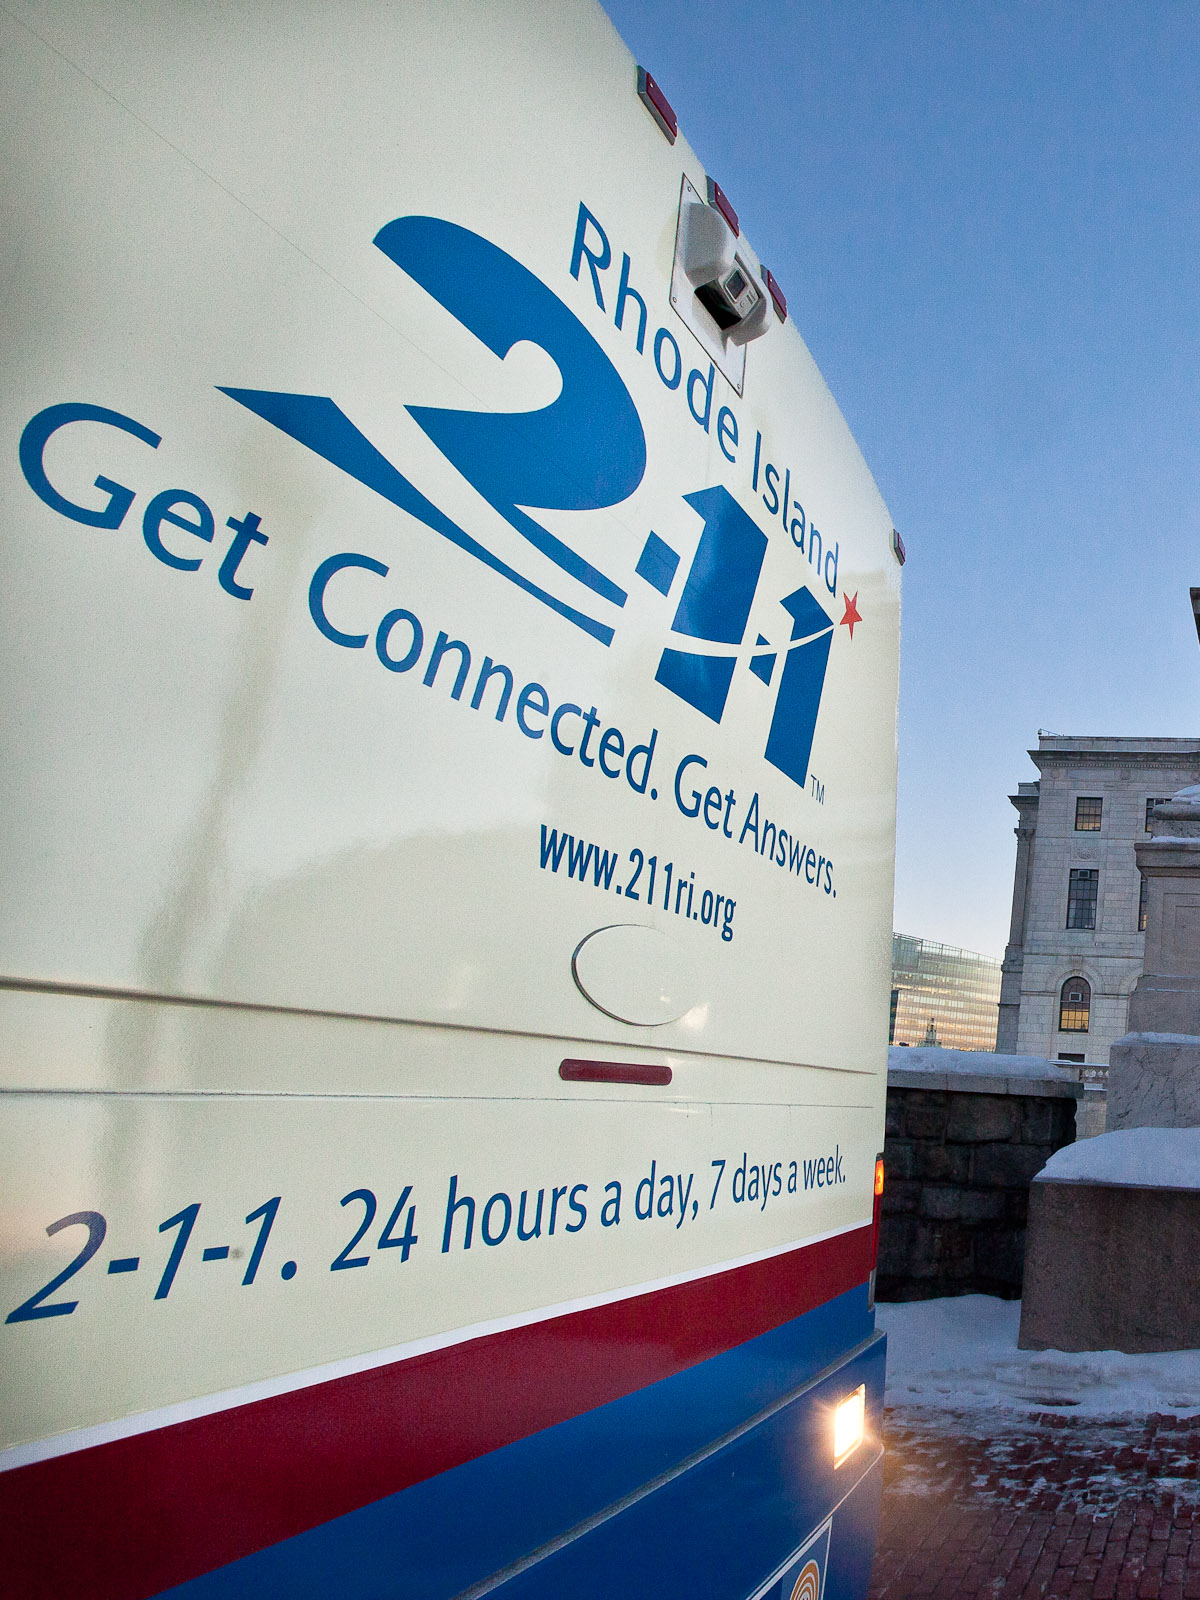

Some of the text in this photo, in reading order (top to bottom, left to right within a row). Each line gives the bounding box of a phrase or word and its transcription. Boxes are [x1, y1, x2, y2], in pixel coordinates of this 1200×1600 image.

[569, 200, 840, 599] Rhode Island
[18, 401, 837, 899] Get Connected. Get Answers.
[810, 773, 826, 806] TM
[539, 823, 737, 943] www.211ri.org
[4, 1143, 847, 1326] 2-1-1. 24 hours a day, 7 days a week.
